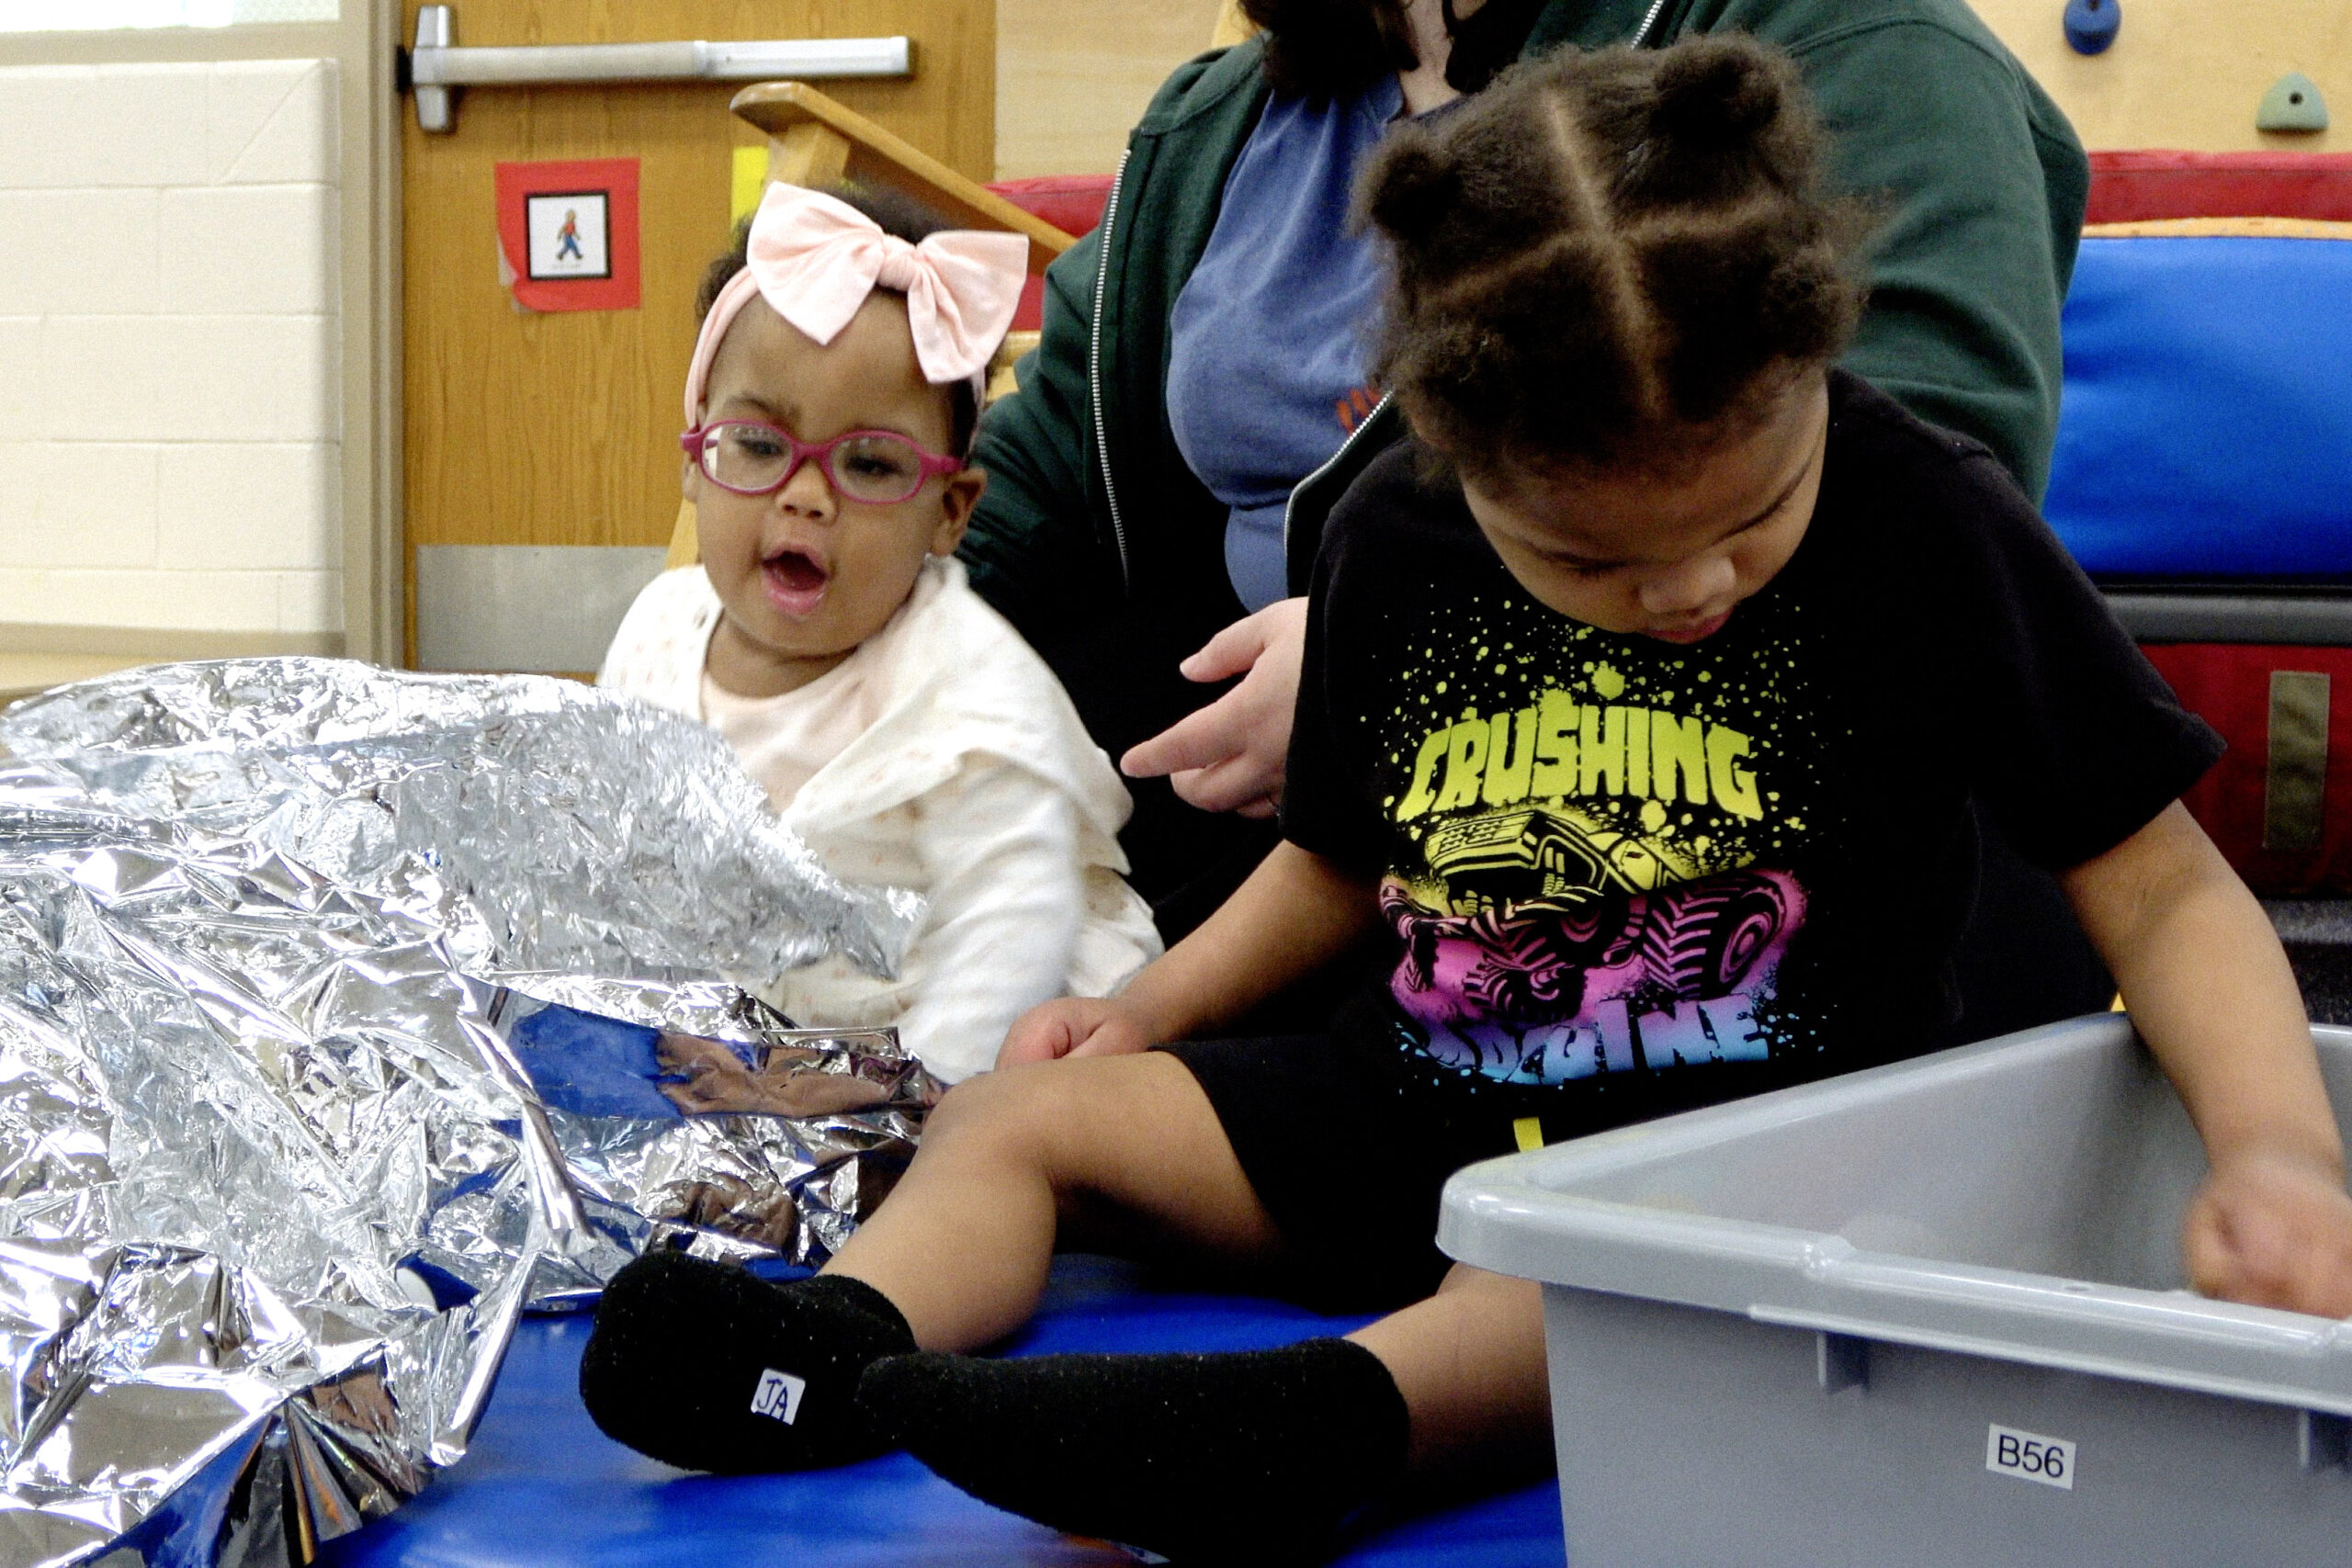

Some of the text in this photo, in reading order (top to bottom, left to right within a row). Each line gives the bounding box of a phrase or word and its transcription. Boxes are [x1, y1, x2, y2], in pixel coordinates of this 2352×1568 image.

[1396, 693, 1764, 821] CRUSHING
[756, 1378, 788, 1422] JA
[1997, 1433, 2065, 1479] B56
